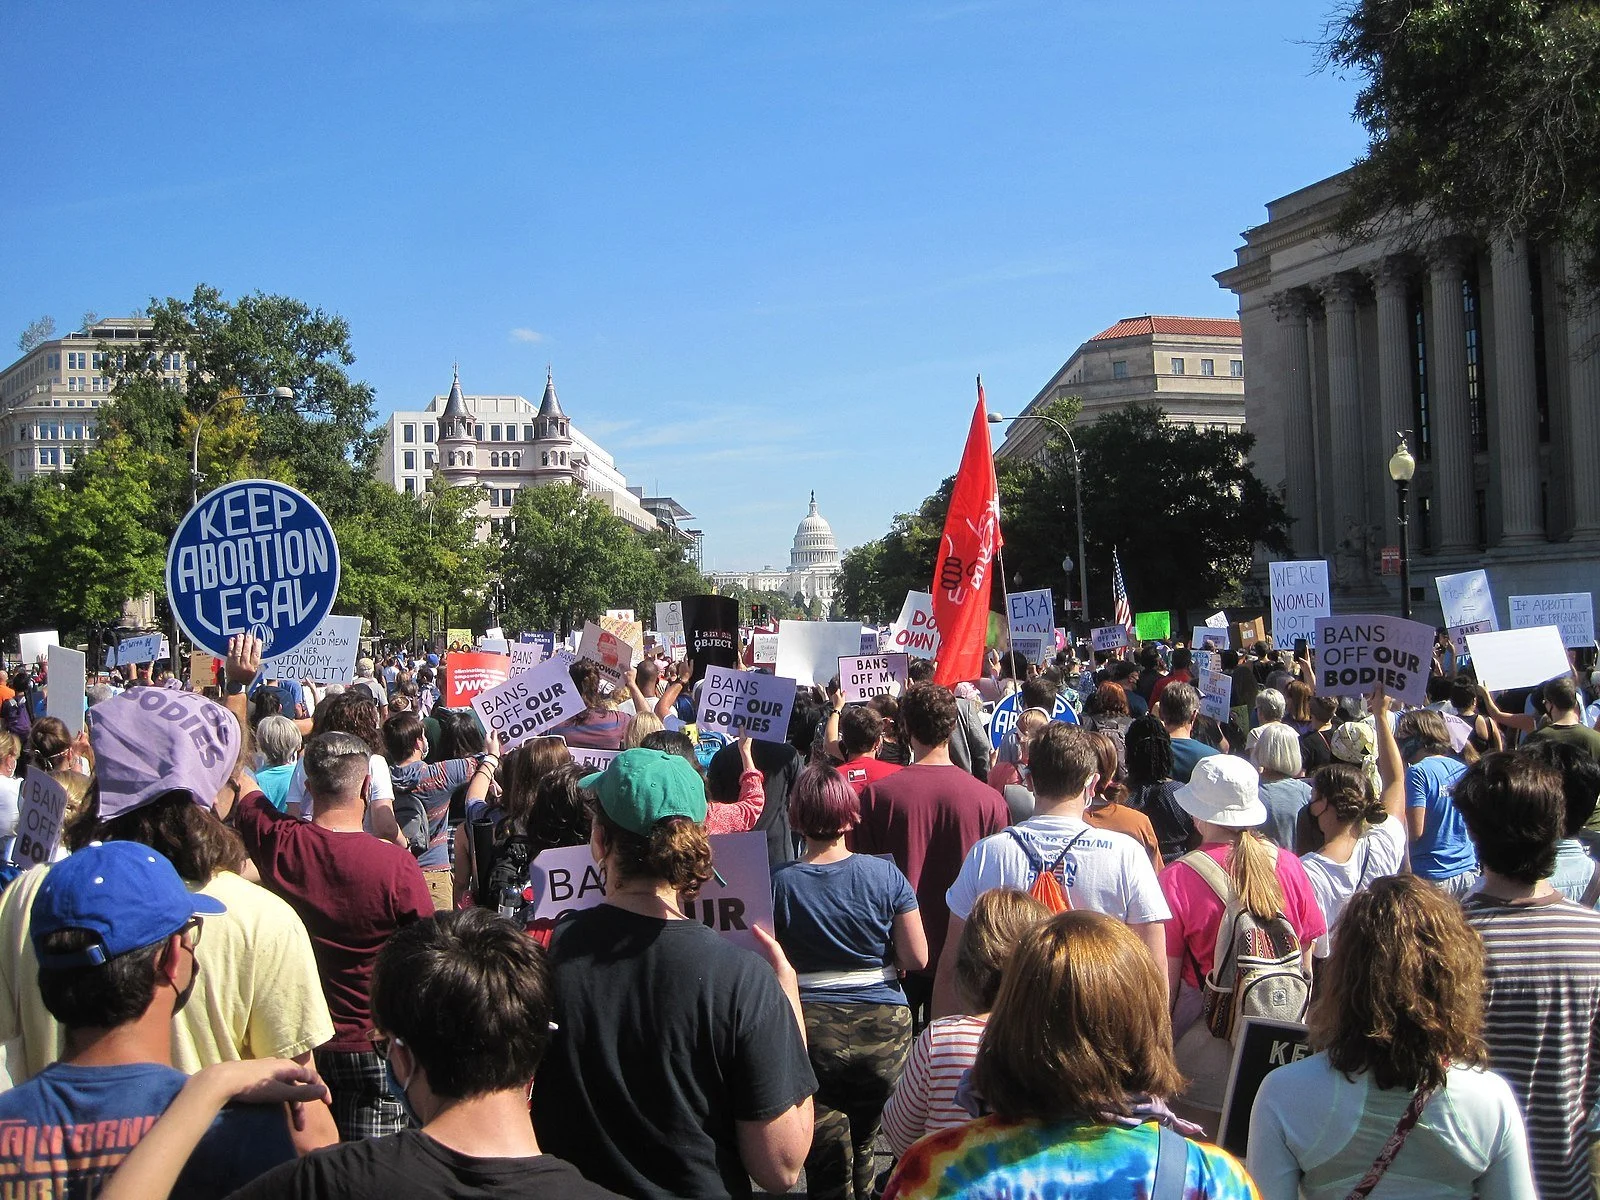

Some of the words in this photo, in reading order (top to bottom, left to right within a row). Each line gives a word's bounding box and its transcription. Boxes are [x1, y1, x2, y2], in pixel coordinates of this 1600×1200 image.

[200, 488, 298, 540] KEEP
[177, 526, 329, 593] ABORTION
[1273, 566, 1320, 587] WE'RE
[195, 579, 318, 635] LEGAL
[1011, 593, 1049, 619] ERA
[1272, 592, 1324, 612] WOMEN
[1276, 615, 1310, 631] NOT
[1549, 611, 1587, 624] PREGNANT
[895, 629, 935, 651] OWN
[1324, 625, 1385, 645] BANS
[1460, 625, 1480, 635] BANS
[304, 647, 318, 655] HER
[306, 637, 327, 646] OULD
[329, 638, 349, 646] MEAN
[274, 655, 332, 666] UTONOMY
[512, 651, 533, 665] BANS
[856, 658, 888, 671] BANS
[1324, 646, 1369, 666] OFF
[1373, 646, 1420, 673] OUR
[276, 665, 348, 680] EQUALITY
[595, 662, 621, 679] POWER
[851, 673, 872, 685] OFF
[879, 671, 896, 683] MY
[1324, 667, 1407, 691] BODIES
[711, 674, 758, 696] BANS
[859, 686, 891, 698] BODY
[481, 682, 528, 715] BANS
[490, 703, 524, 730] OFF
[525, 682, 567, 711] OUR
[707, 692, 745, 710] OFF
[747, 699, 783, 717] OUR
[497, 702, 564, 746] BODIES
[704, 709, 771, 733] BODIES
[32, 781, 65, 818] BAN
[28, 809, 57, 840] OFF
[549, 865, 607, 902] BA
[684, 897, 749, 932] UR
[1269, 1040, 1309, 1065] KE
